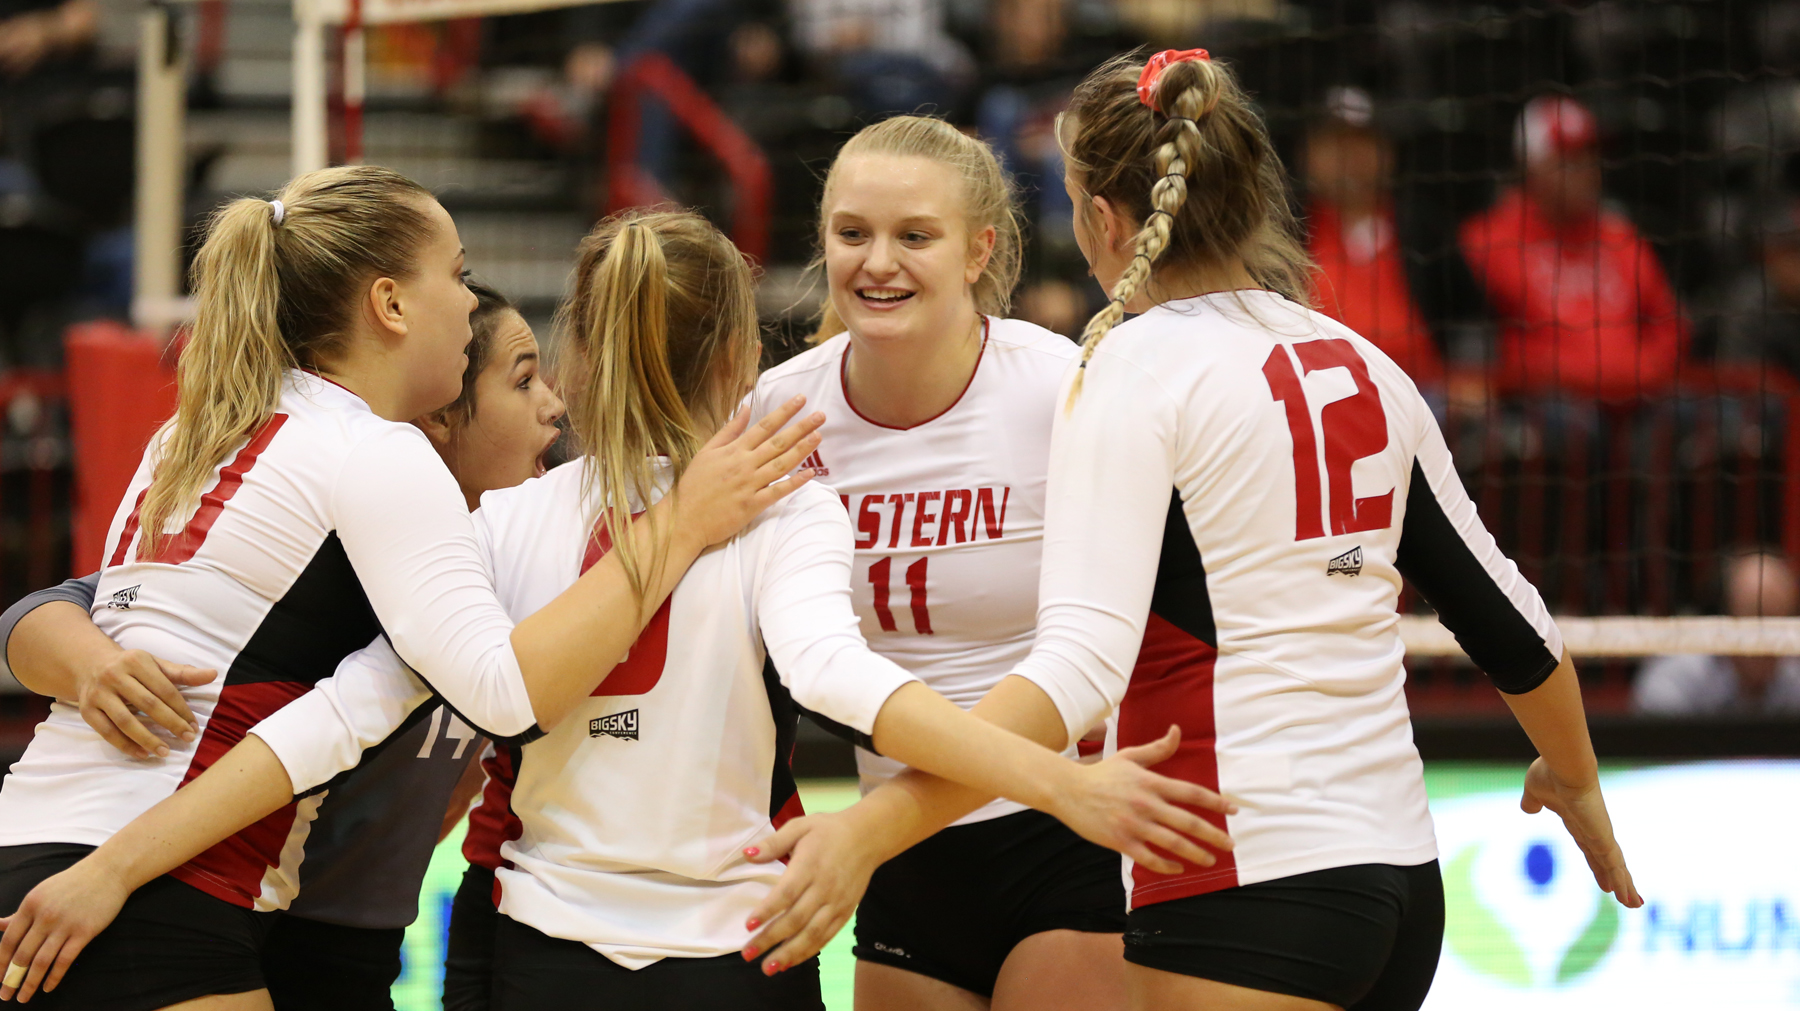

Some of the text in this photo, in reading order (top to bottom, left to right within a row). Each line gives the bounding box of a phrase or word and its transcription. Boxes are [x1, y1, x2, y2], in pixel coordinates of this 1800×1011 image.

[1262, 338, 1396, 541] 12
[840, 486, 1011, 549] STERN
[868, 556, 934, 635] 11
[416, 704, 477, 759] 14
[590, 711, 638, 731] BIGSKY
